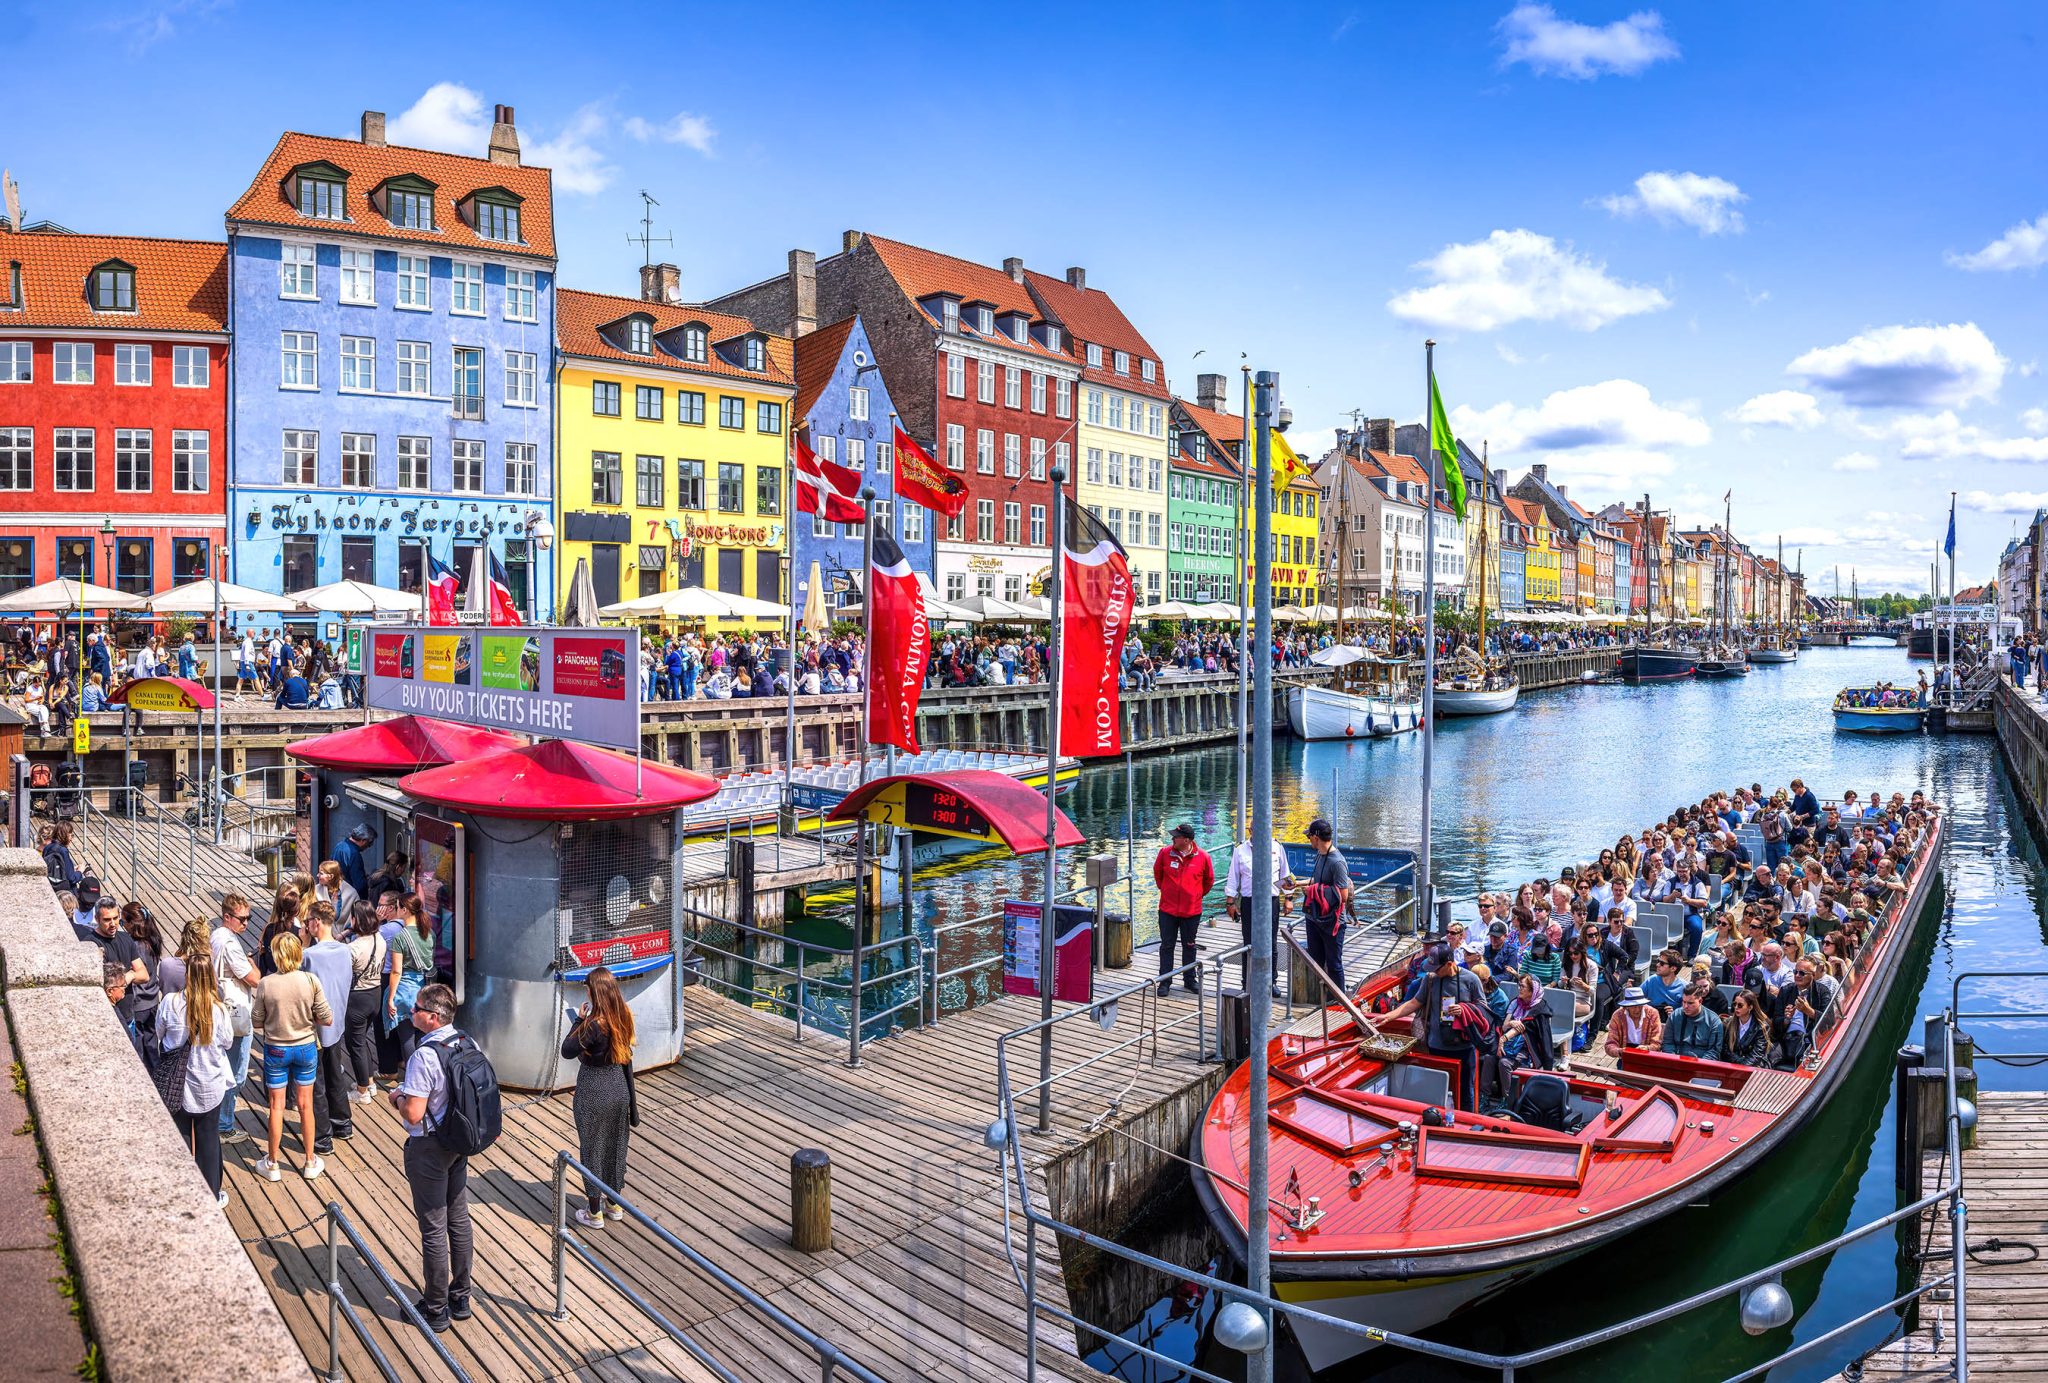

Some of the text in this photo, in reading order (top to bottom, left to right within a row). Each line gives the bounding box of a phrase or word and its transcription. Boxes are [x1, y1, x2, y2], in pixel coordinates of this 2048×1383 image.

[646, 520, 660, 541] 7
[1183, 556, 1221, 571] HEERING
[565, 655, 598, 666] PANORAMA
[135, 699, 175, 707] COPENHAGEN
[402, 684, 573, 731] BUY YOUR TICKETS HERE
[883, 804, 893, 824] 2
[587, 937, 664, 959] STRA.COM
